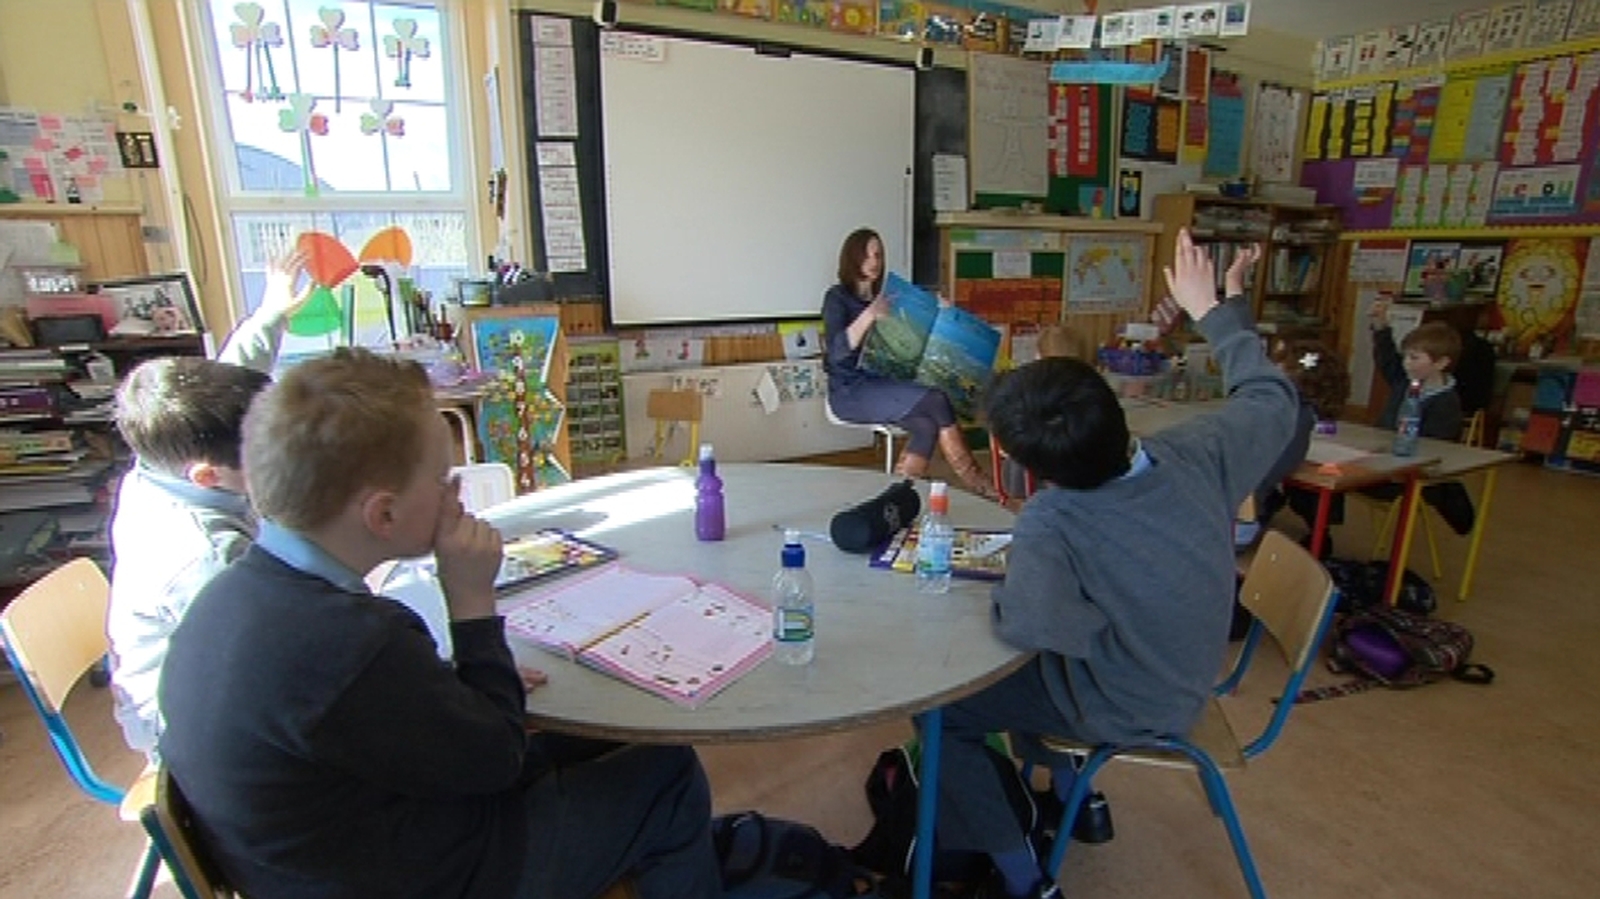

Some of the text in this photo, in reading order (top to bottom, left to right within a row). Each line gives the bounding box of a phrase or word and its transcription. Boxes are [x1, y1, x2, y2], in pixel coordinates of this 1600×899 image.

[510, 330, 524, 345] 10
[512, 356, 523, 370] 9
[516, 402, 526, 416] 7
[518, 427, 528, 440] 6
[521, 473, 531, 487] 4
